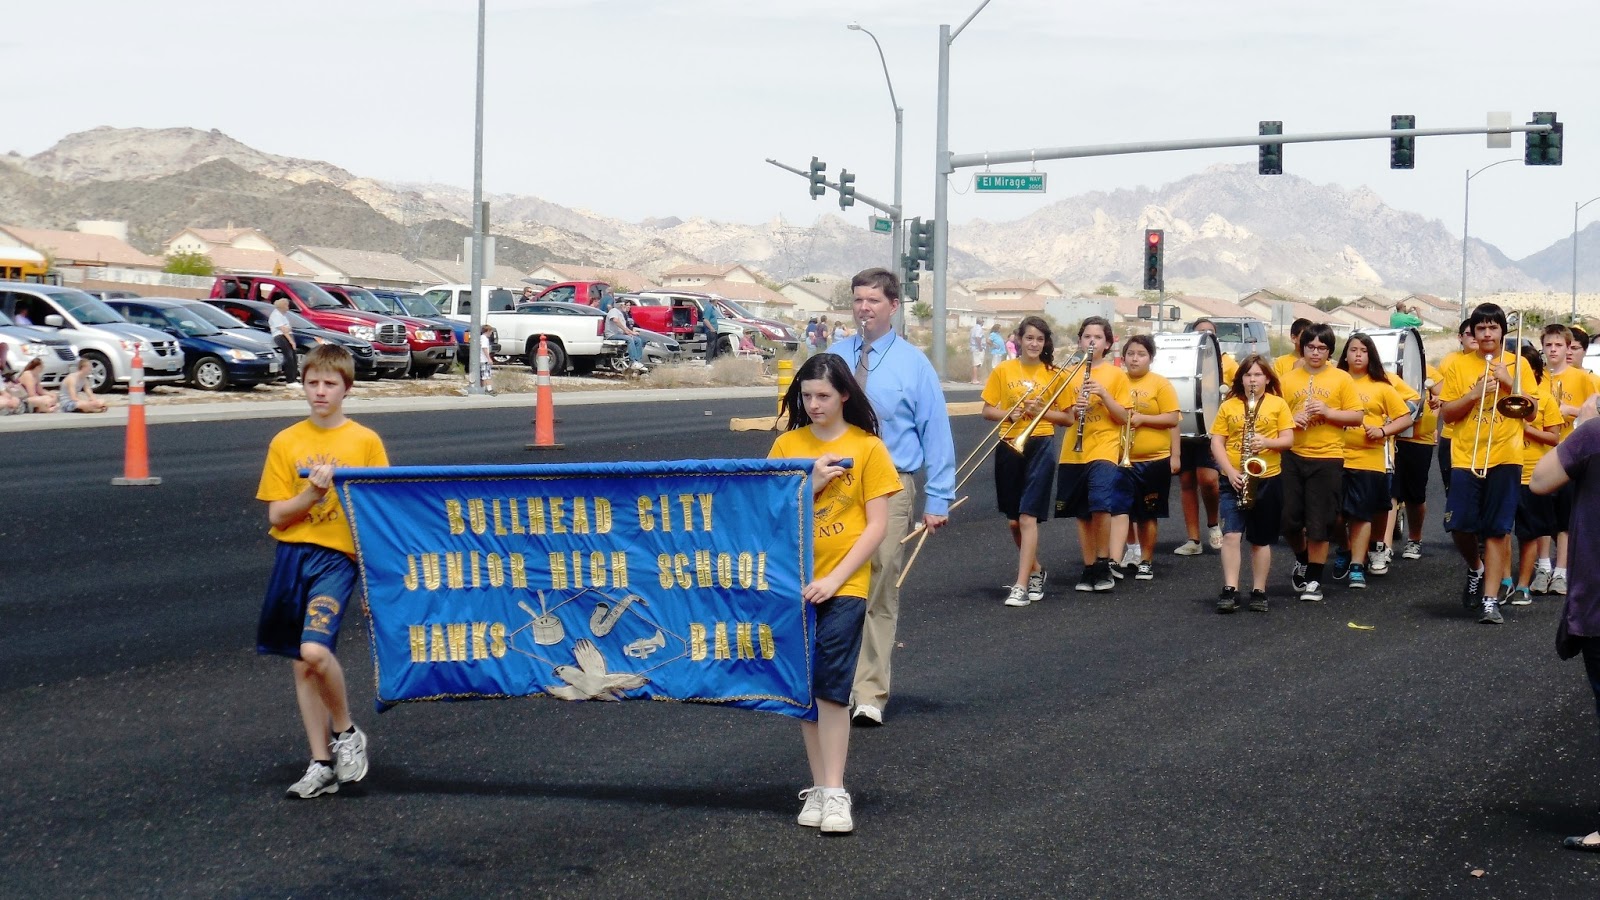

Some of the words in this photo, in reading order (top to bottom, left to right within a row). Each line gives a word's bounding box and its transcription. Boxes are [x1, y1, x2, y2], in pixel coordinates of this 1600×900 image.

[983, 176, 992, 186] El
[994, 176, 1026, 189] Mirage
[1293, 386, 1331, 399] HAWKS
[447, 497, 612, 535] BULLHEAD
[638, 494, 713, 532] CITY
[813, 522, 844, 538] ND
[404, 551, 527, 591] JUNIOR
[549, 551, 628, 590] HIGH
[658, 550, 769, 591] SCHOOL
[409, 622, 506, 662] HAWKS
[690, 622, 775, 660] BAND
